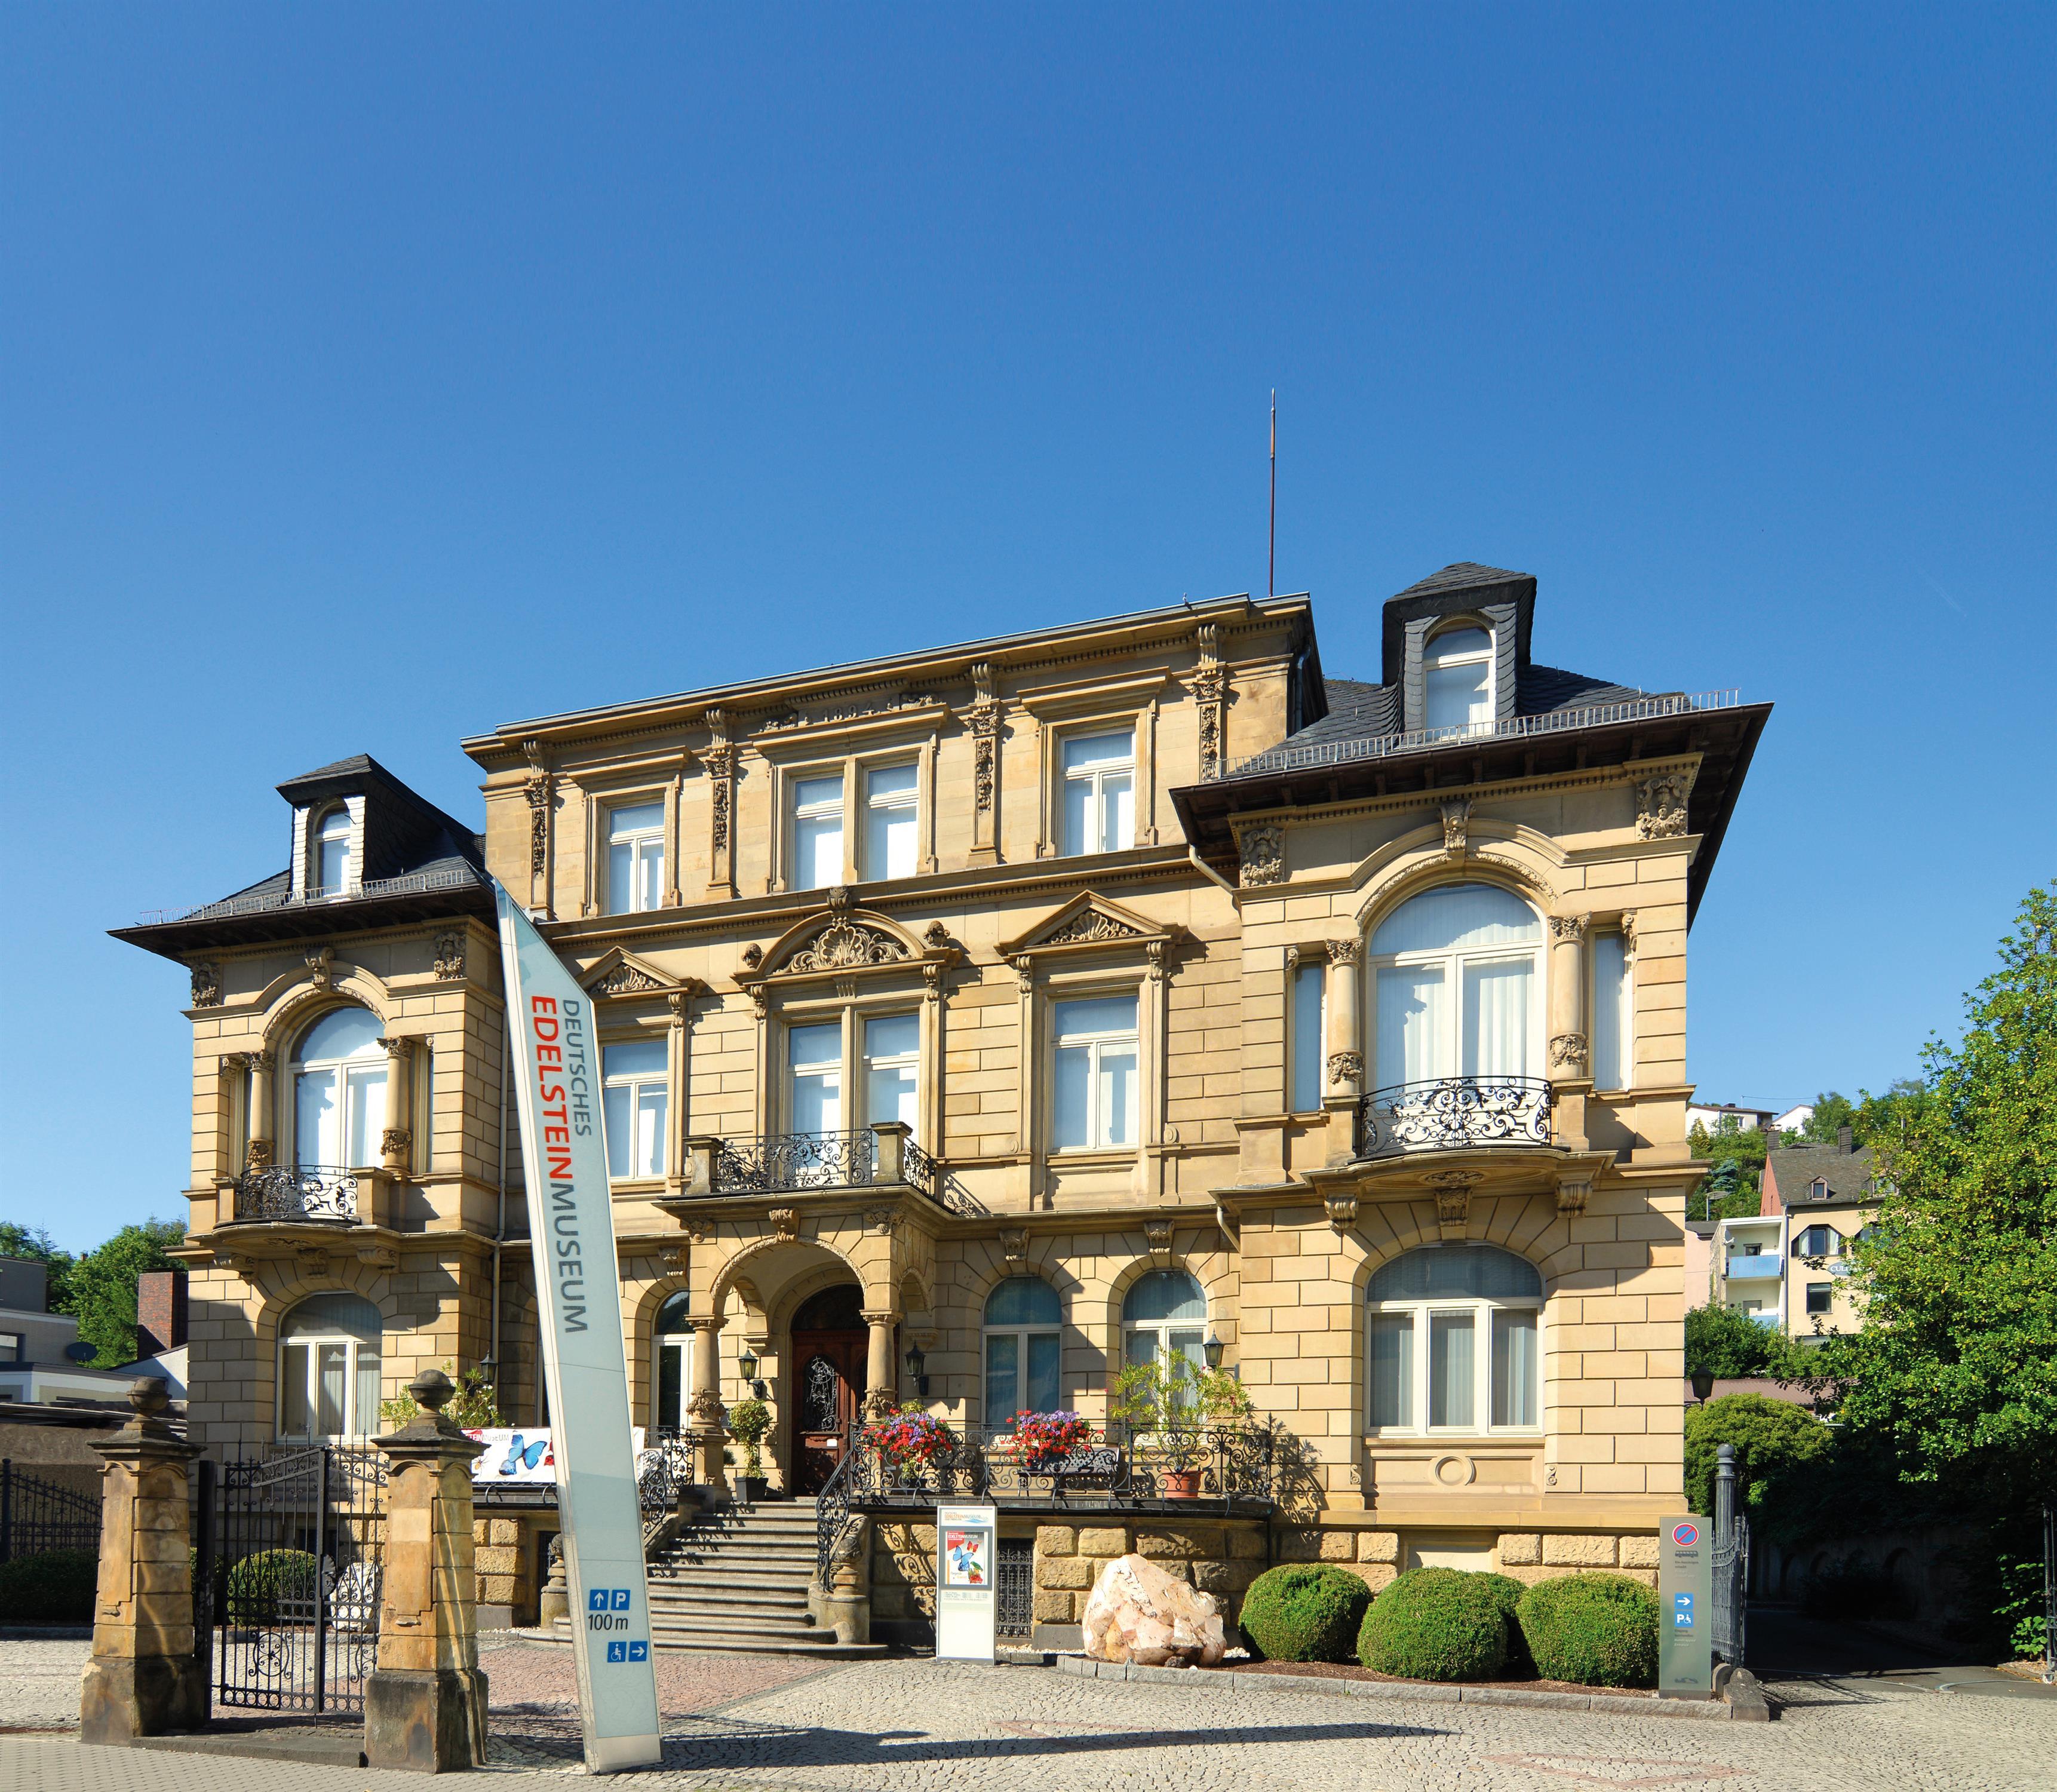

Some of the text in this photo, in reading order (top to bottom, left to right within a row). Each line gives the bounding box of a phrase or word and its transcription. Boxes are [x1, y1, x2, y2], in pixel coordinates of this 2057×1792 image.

[563, 999, 591, 1136] DEUTSCHES
[532, 996, 588, 1333] EDELSTEINMUSEUM
[616, 1592, 626, 1607] P
[588, 1614, 628, 1630] 100 m
[1677, 1614, 1684, 1623] P
